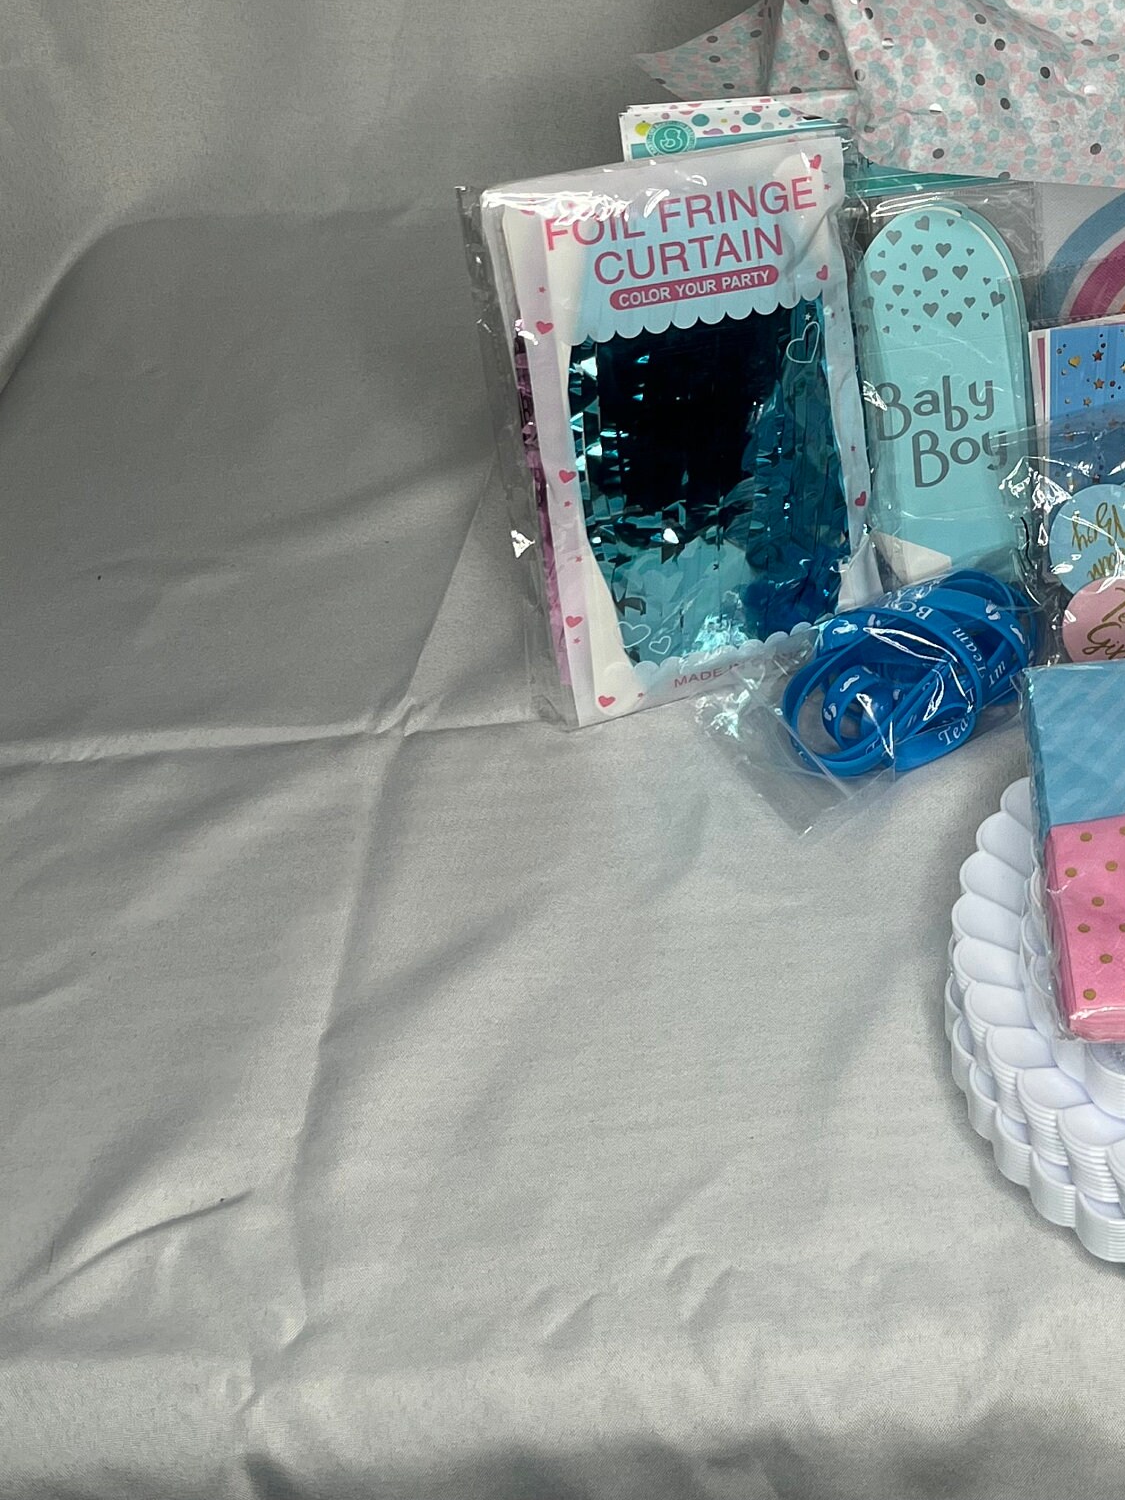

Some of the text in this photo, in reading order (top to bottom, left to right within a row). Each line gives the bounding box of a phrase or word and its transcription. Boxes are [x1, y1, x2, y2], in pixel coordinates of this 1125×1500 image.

[545, 176, 817, 251] FOIL FRINGE
[594, 224, 784, 285] CURTAIN
[618, 270, 770, 308] COLOR YOUR PARTY
[875, 375, 995, 442] Baby
[912, 429, 1008, 488] Boy
[674, 667, 723, 688] MADE
[952, 627, 987, 678] Team
[938, 717, 969, 746] Tea
